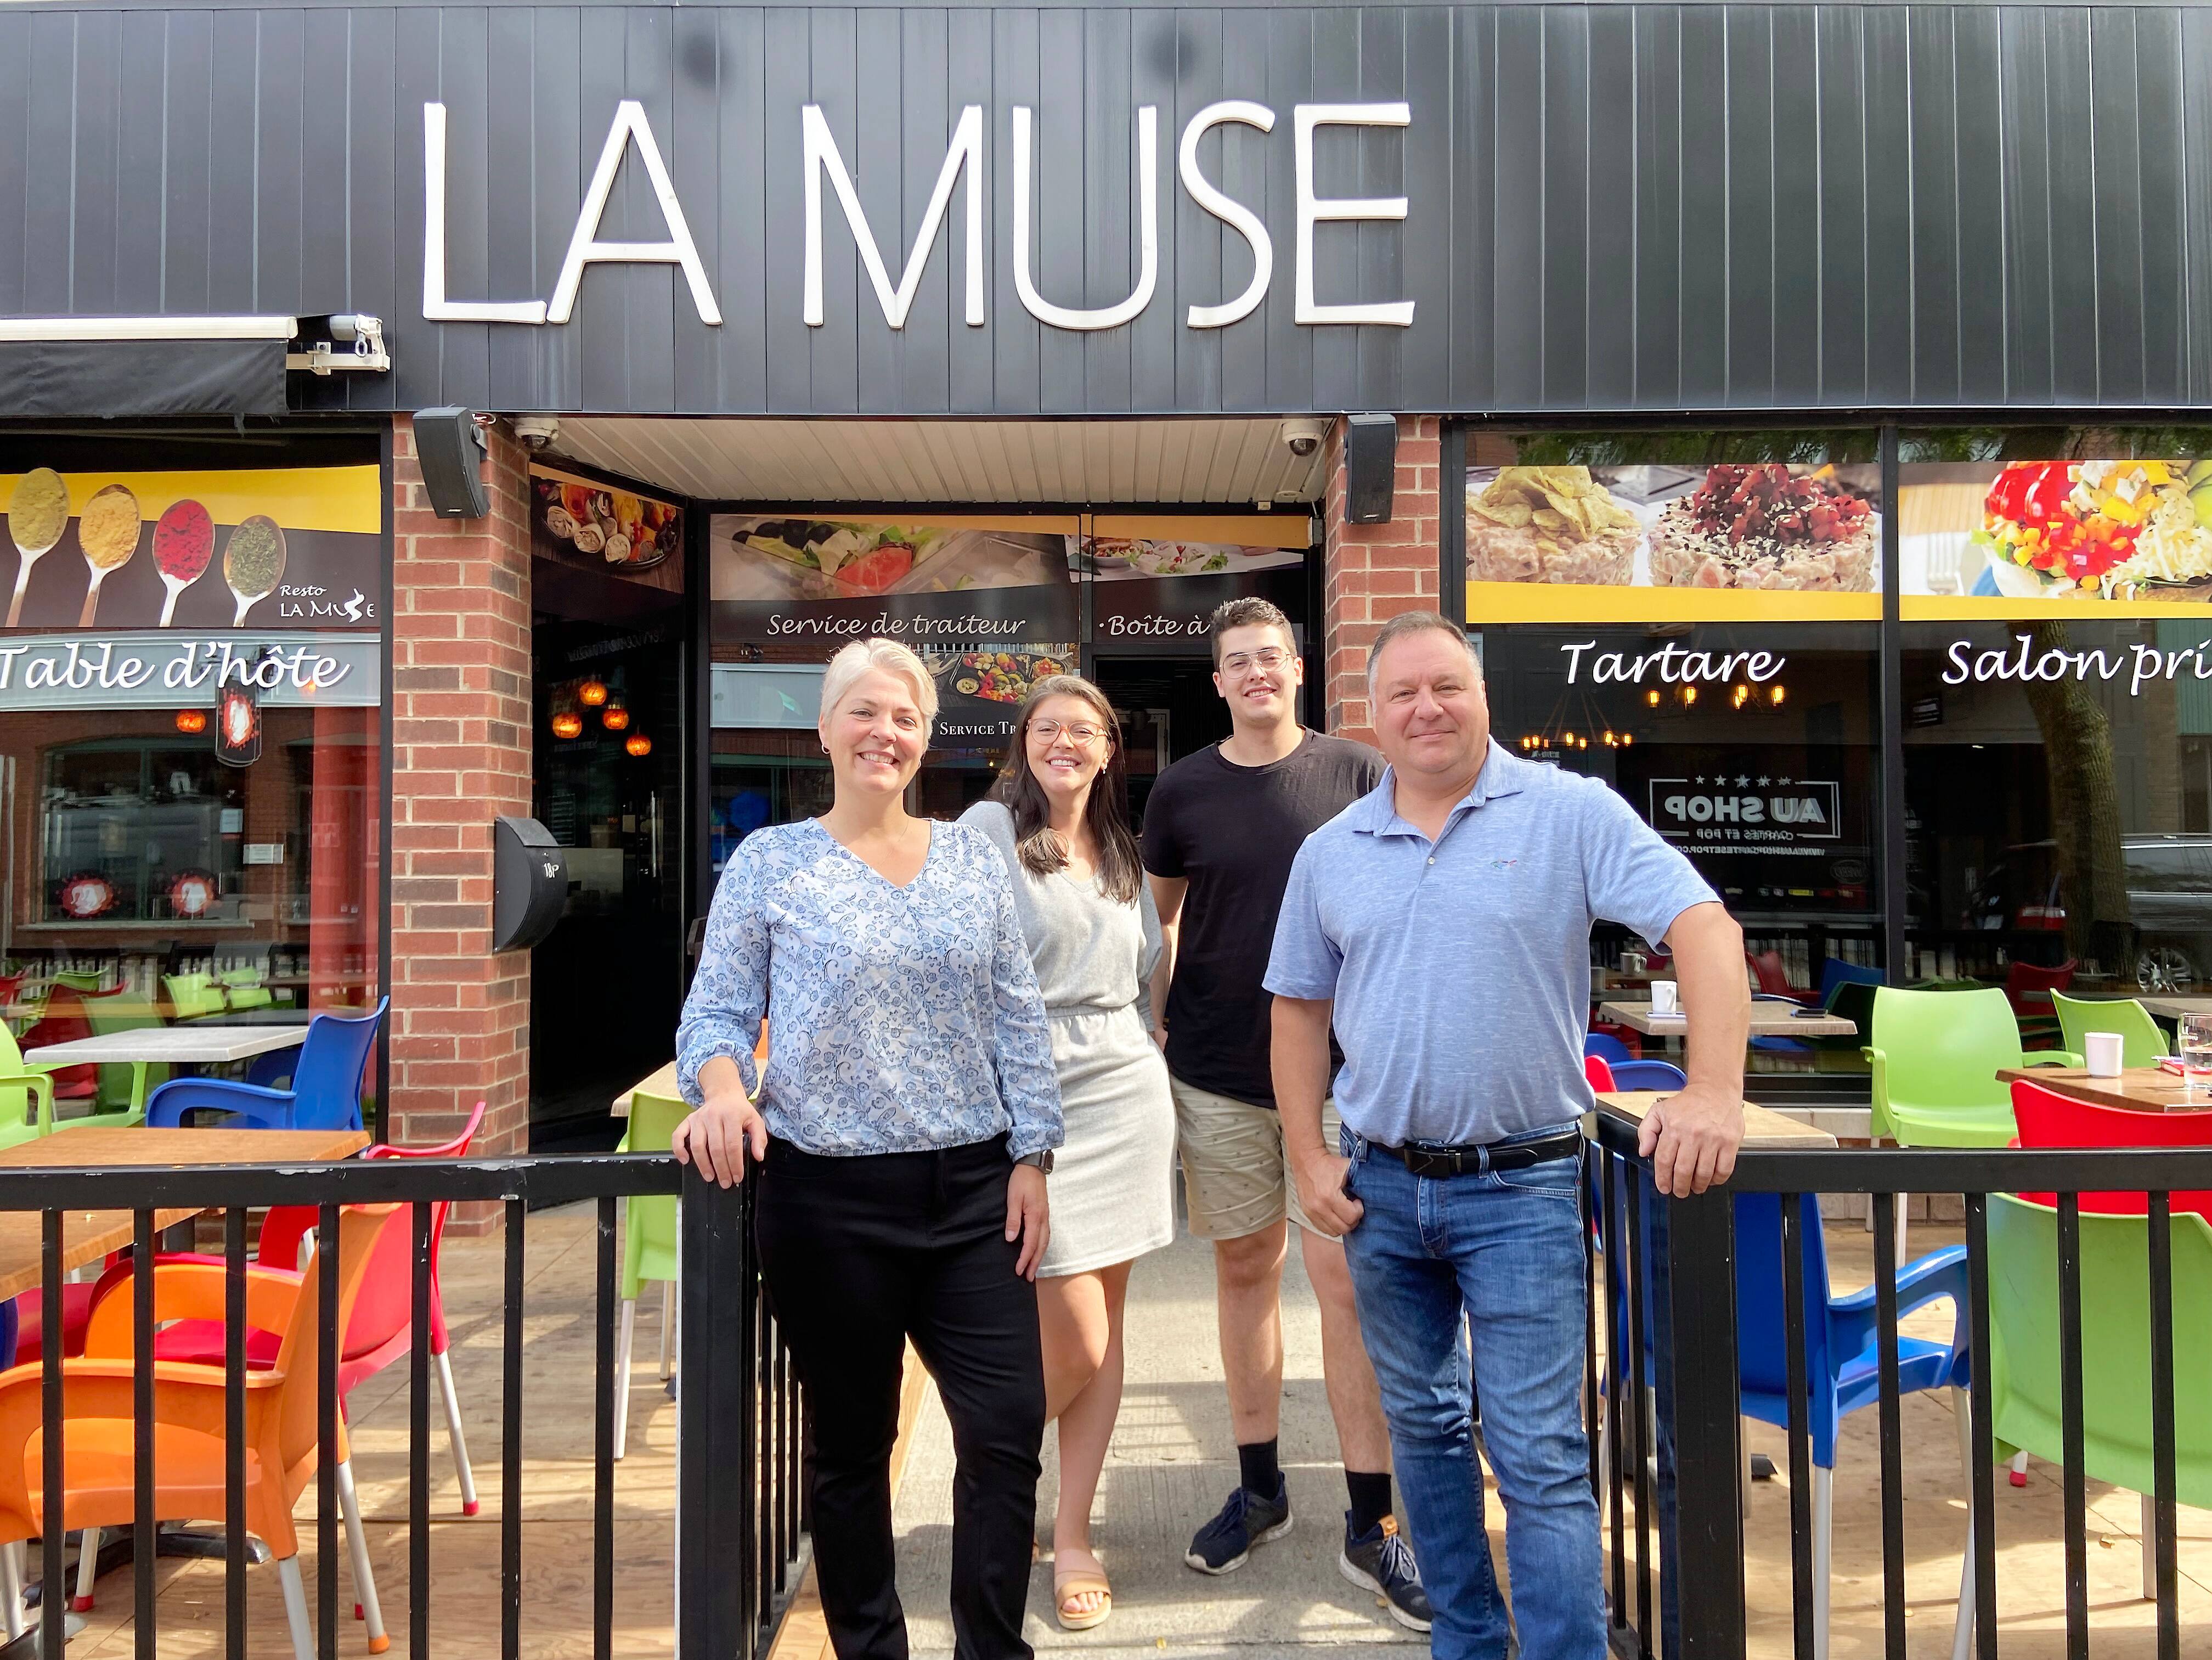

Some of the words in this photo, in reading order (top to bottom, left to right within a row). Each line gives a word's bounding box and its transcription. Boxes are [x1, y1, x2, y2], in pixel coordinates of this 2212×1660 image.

[422, 100, 724, 327] LA
[802, 100, 1415, 330] MUSE
[280, 584, 328, 597] Resto
[280, 603, 304, 617] LA
[309, 588, 375, 623] MUSE
[767, 614, 868, 635] Service
[871, 611, 911, 635] de
[912, 614, 1026, 635] traiteur
[1187, 614, 1211, 635] à
[0, 641, 156, 689] Table
[163, 641, 351, 689] d'hôte
[1560, 639, 1786, 684] Tartare
[1942, 634, 2125, 684] Salon
[940, 721, 995, 735] SERVICE
